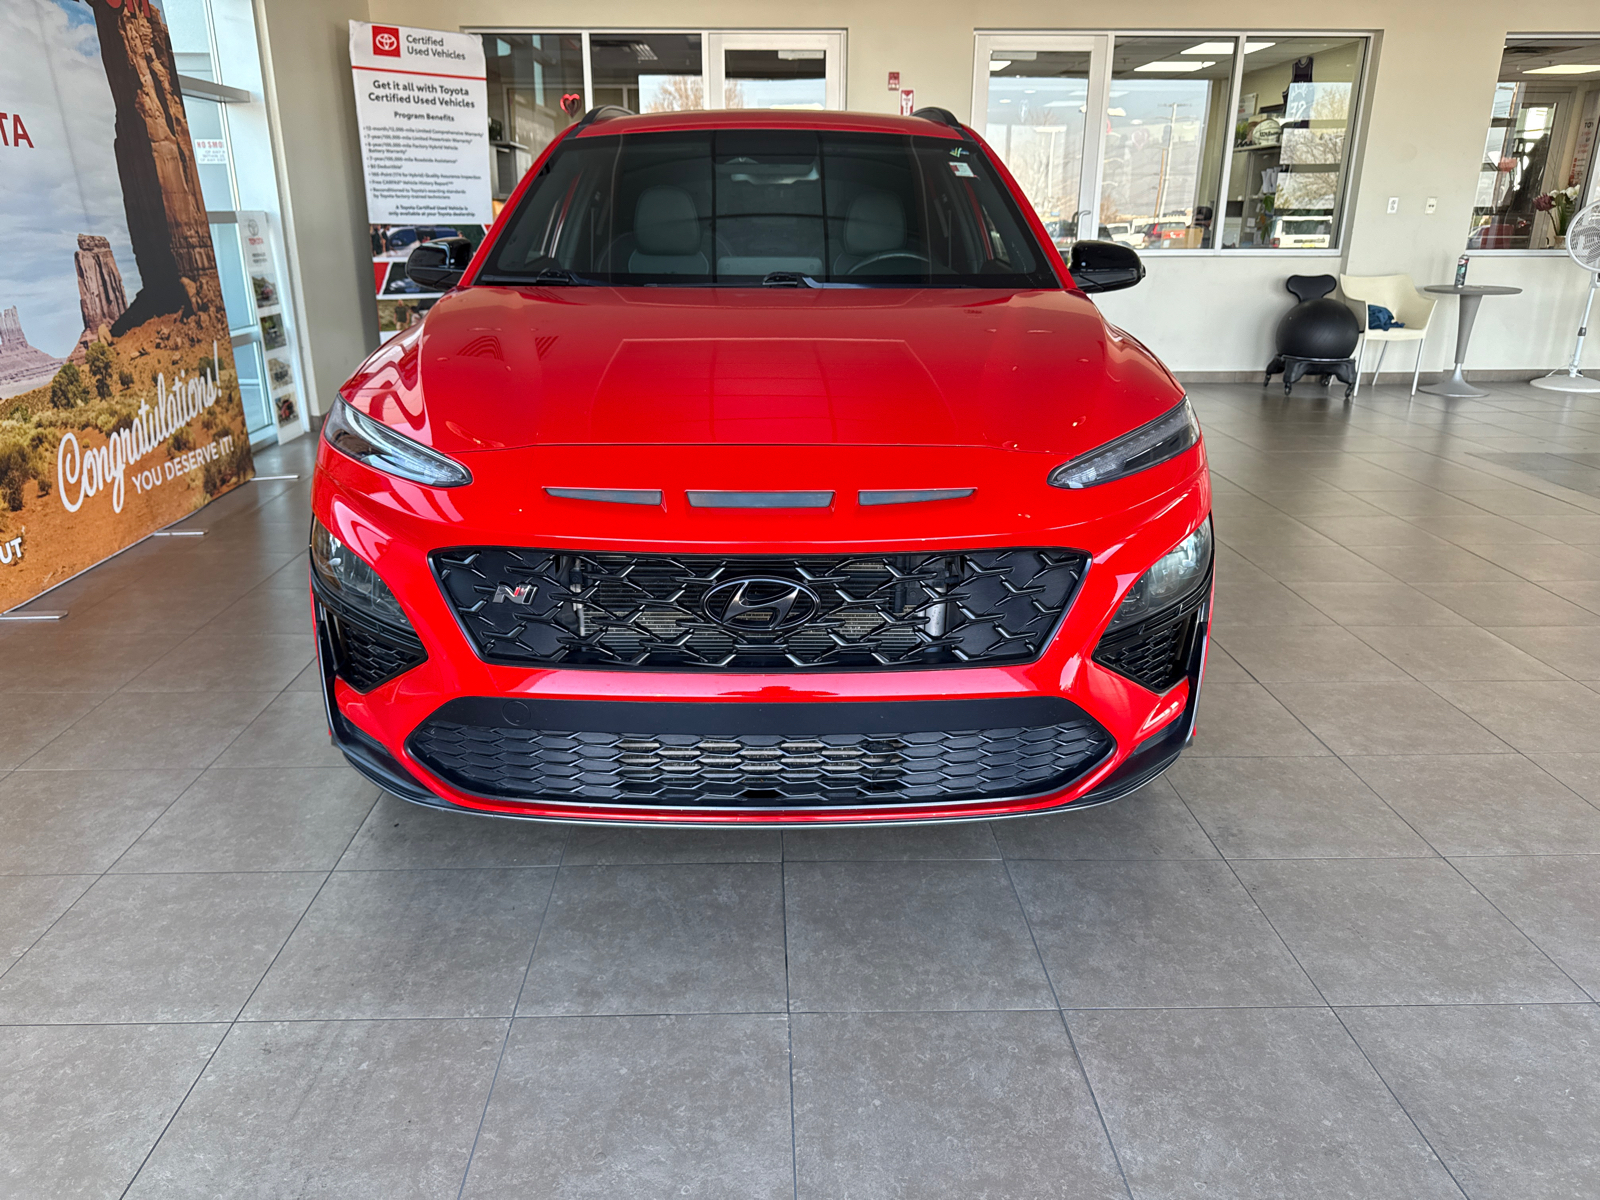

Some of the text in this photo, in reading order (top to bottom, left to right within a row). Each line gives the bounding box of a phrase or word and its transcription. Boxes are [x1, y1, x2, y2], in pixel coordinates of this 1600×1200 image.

[406, 34, 444, 46] Certified
[407, 46, 466, 60] Used Vehicles
[373, 80, 469, 96] Get it all with Toyota
[368, 92, 475, 108] Certified Used Vehicles
[394, 111, 454, 122] Program Benefits
[58, 340, 222, 514] Congratulations!
[132, 435, 234, 494] YOU DESERVE IT!
